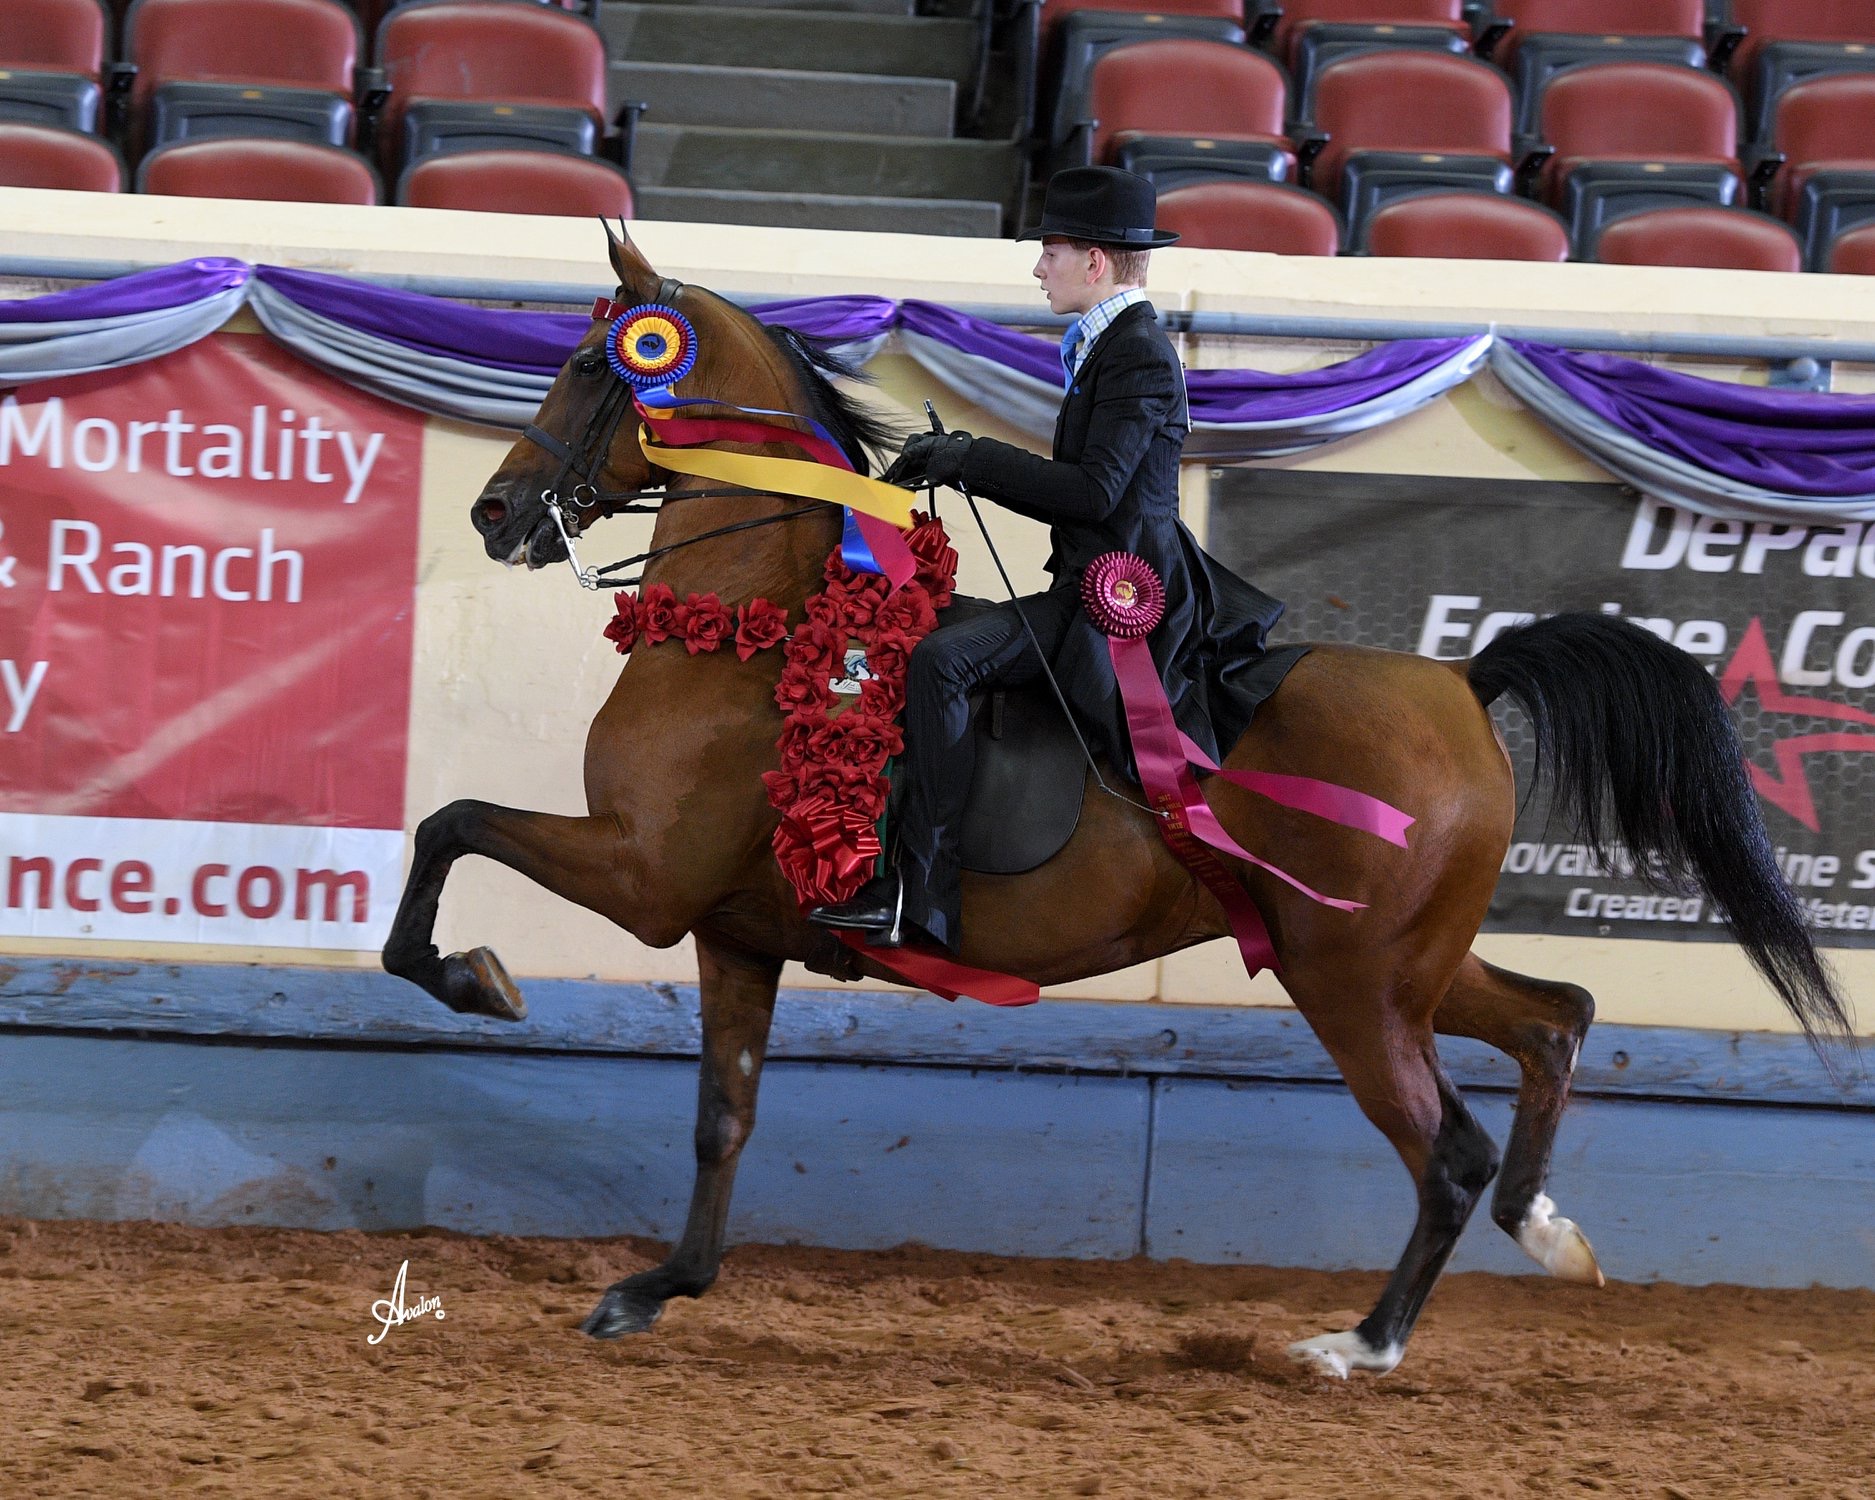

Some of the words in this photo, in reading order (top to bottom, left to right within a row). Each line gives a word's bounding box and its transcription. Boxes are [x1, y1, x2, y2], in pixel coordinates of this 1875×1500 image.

[0, 395, 384, 503] Mortality
[47, 518, 304, 603] Ranch
[0, 659, 49, 732] y
[7, 855, 370, 923] nce.com
[1563, 887, 1703, 923] Created
